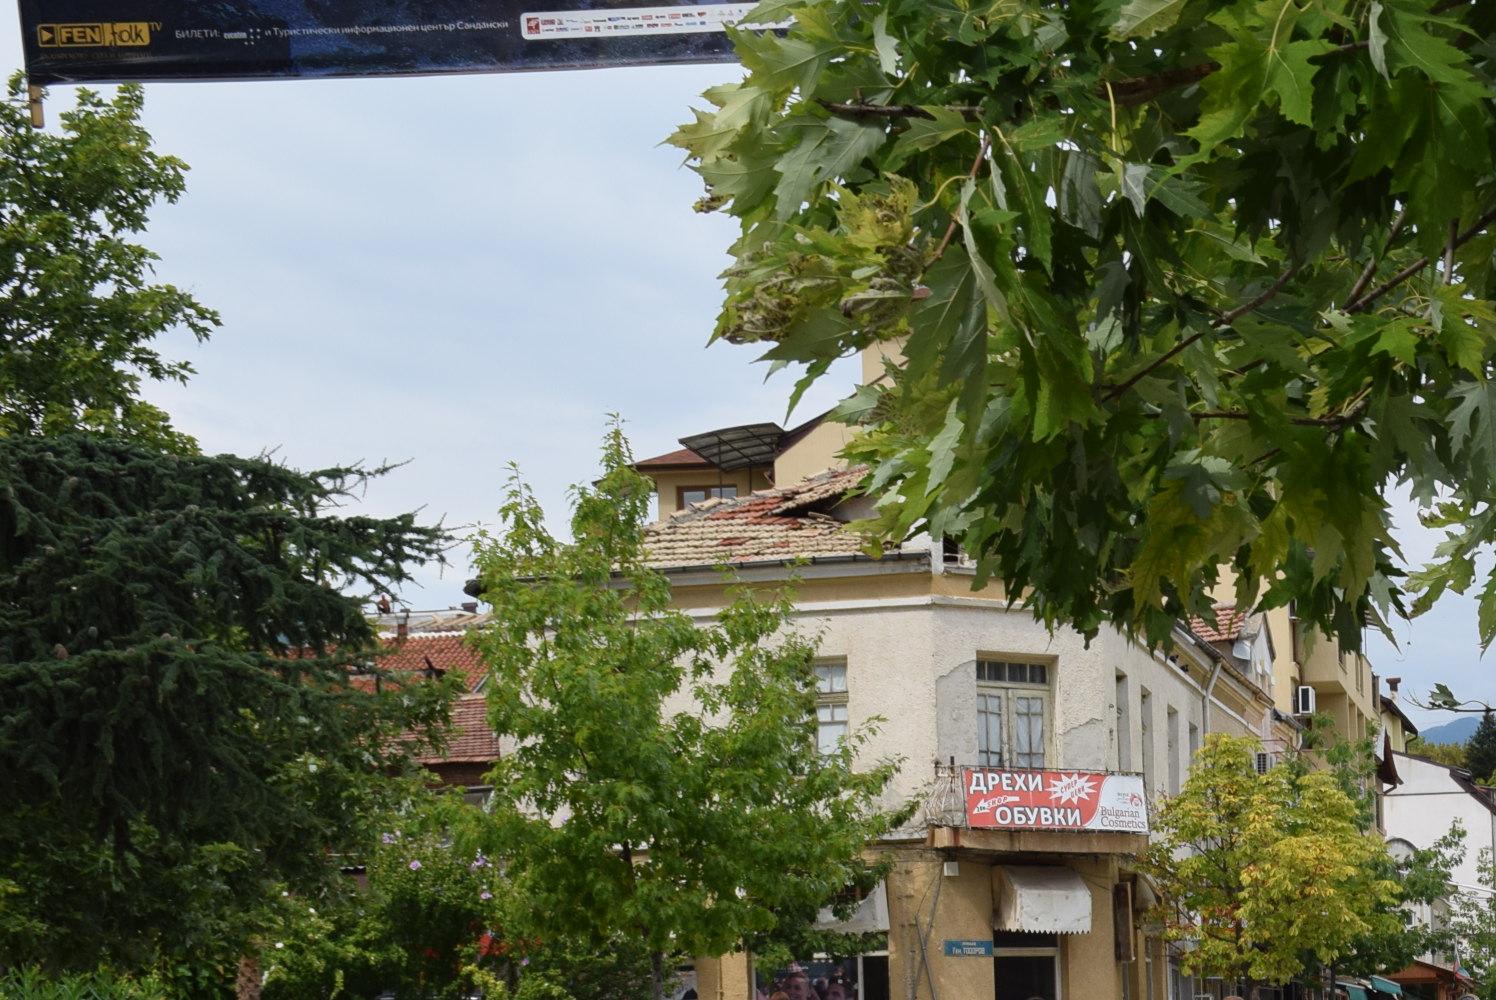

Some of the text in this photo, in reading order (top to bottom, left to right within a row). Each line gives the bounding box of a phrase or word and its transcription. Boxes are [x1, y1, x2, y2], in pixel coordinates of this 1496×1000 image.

[61, 22, 163, 46] FEN folk TV
[175, 28, 221, 39] БИЛЕТИ:
[341, 24, 419, 36] информационен
[420, 22, 455, 33] център
[456, 20, 509, 31] Сандански
[970, 772, 1043, 795] ДРЕХИ
[987, 796, 1009, 808] SHOP
[995, 806, 1082, 827] ОБУВКИ
[1101, 806, 1140, 818] Bulgarian
[1101, 816, 1146, 829] Cosmetics
